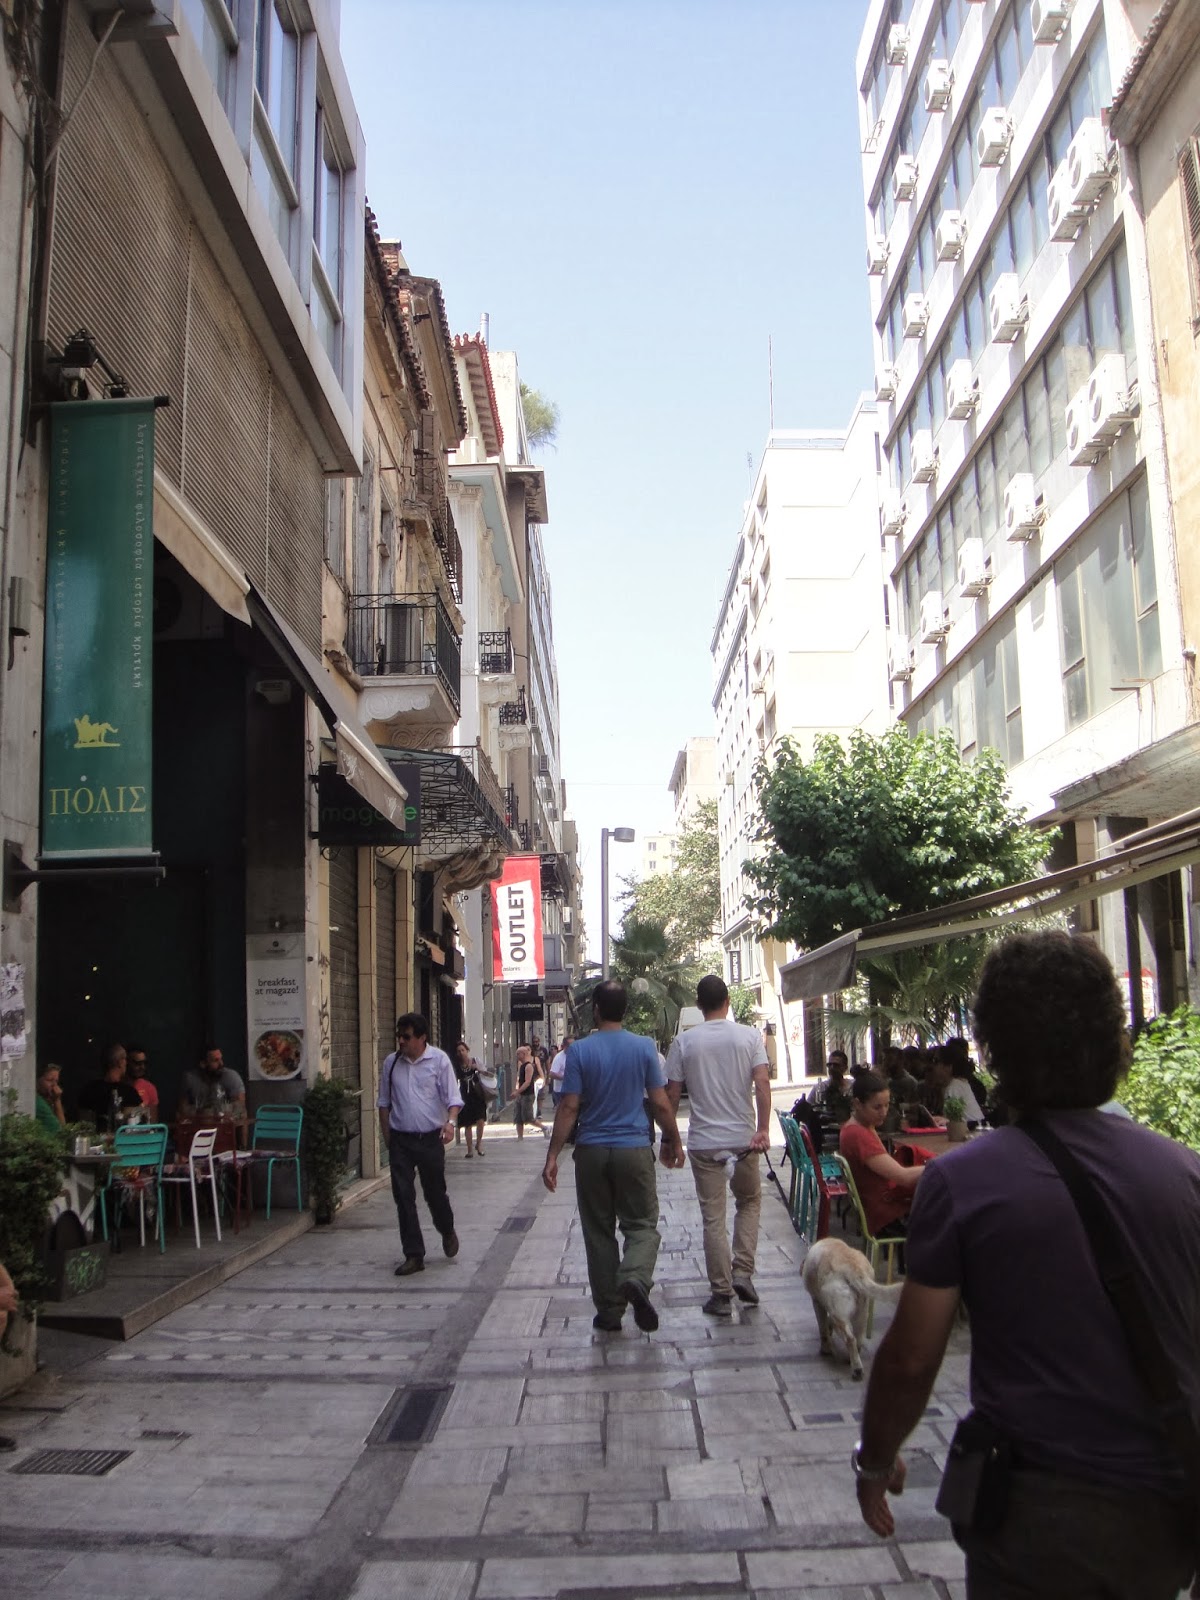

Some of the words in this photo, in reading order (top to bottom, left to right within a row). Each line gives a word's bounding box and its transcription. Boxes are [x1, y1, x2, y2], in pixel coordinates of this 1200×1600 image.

[133, 503, 145, 570] φιλοσοφία
[132, 577, 144, 628] ιστορία
[132, 636, 143, 688] κριτική
[48, 786, 147, 815] ΠΟΛΙΣ
[507, 886, 527, 963] OUTLET
[258, 978, 296, 987] breakfast
[266, 985, 299, 996] magaze!
